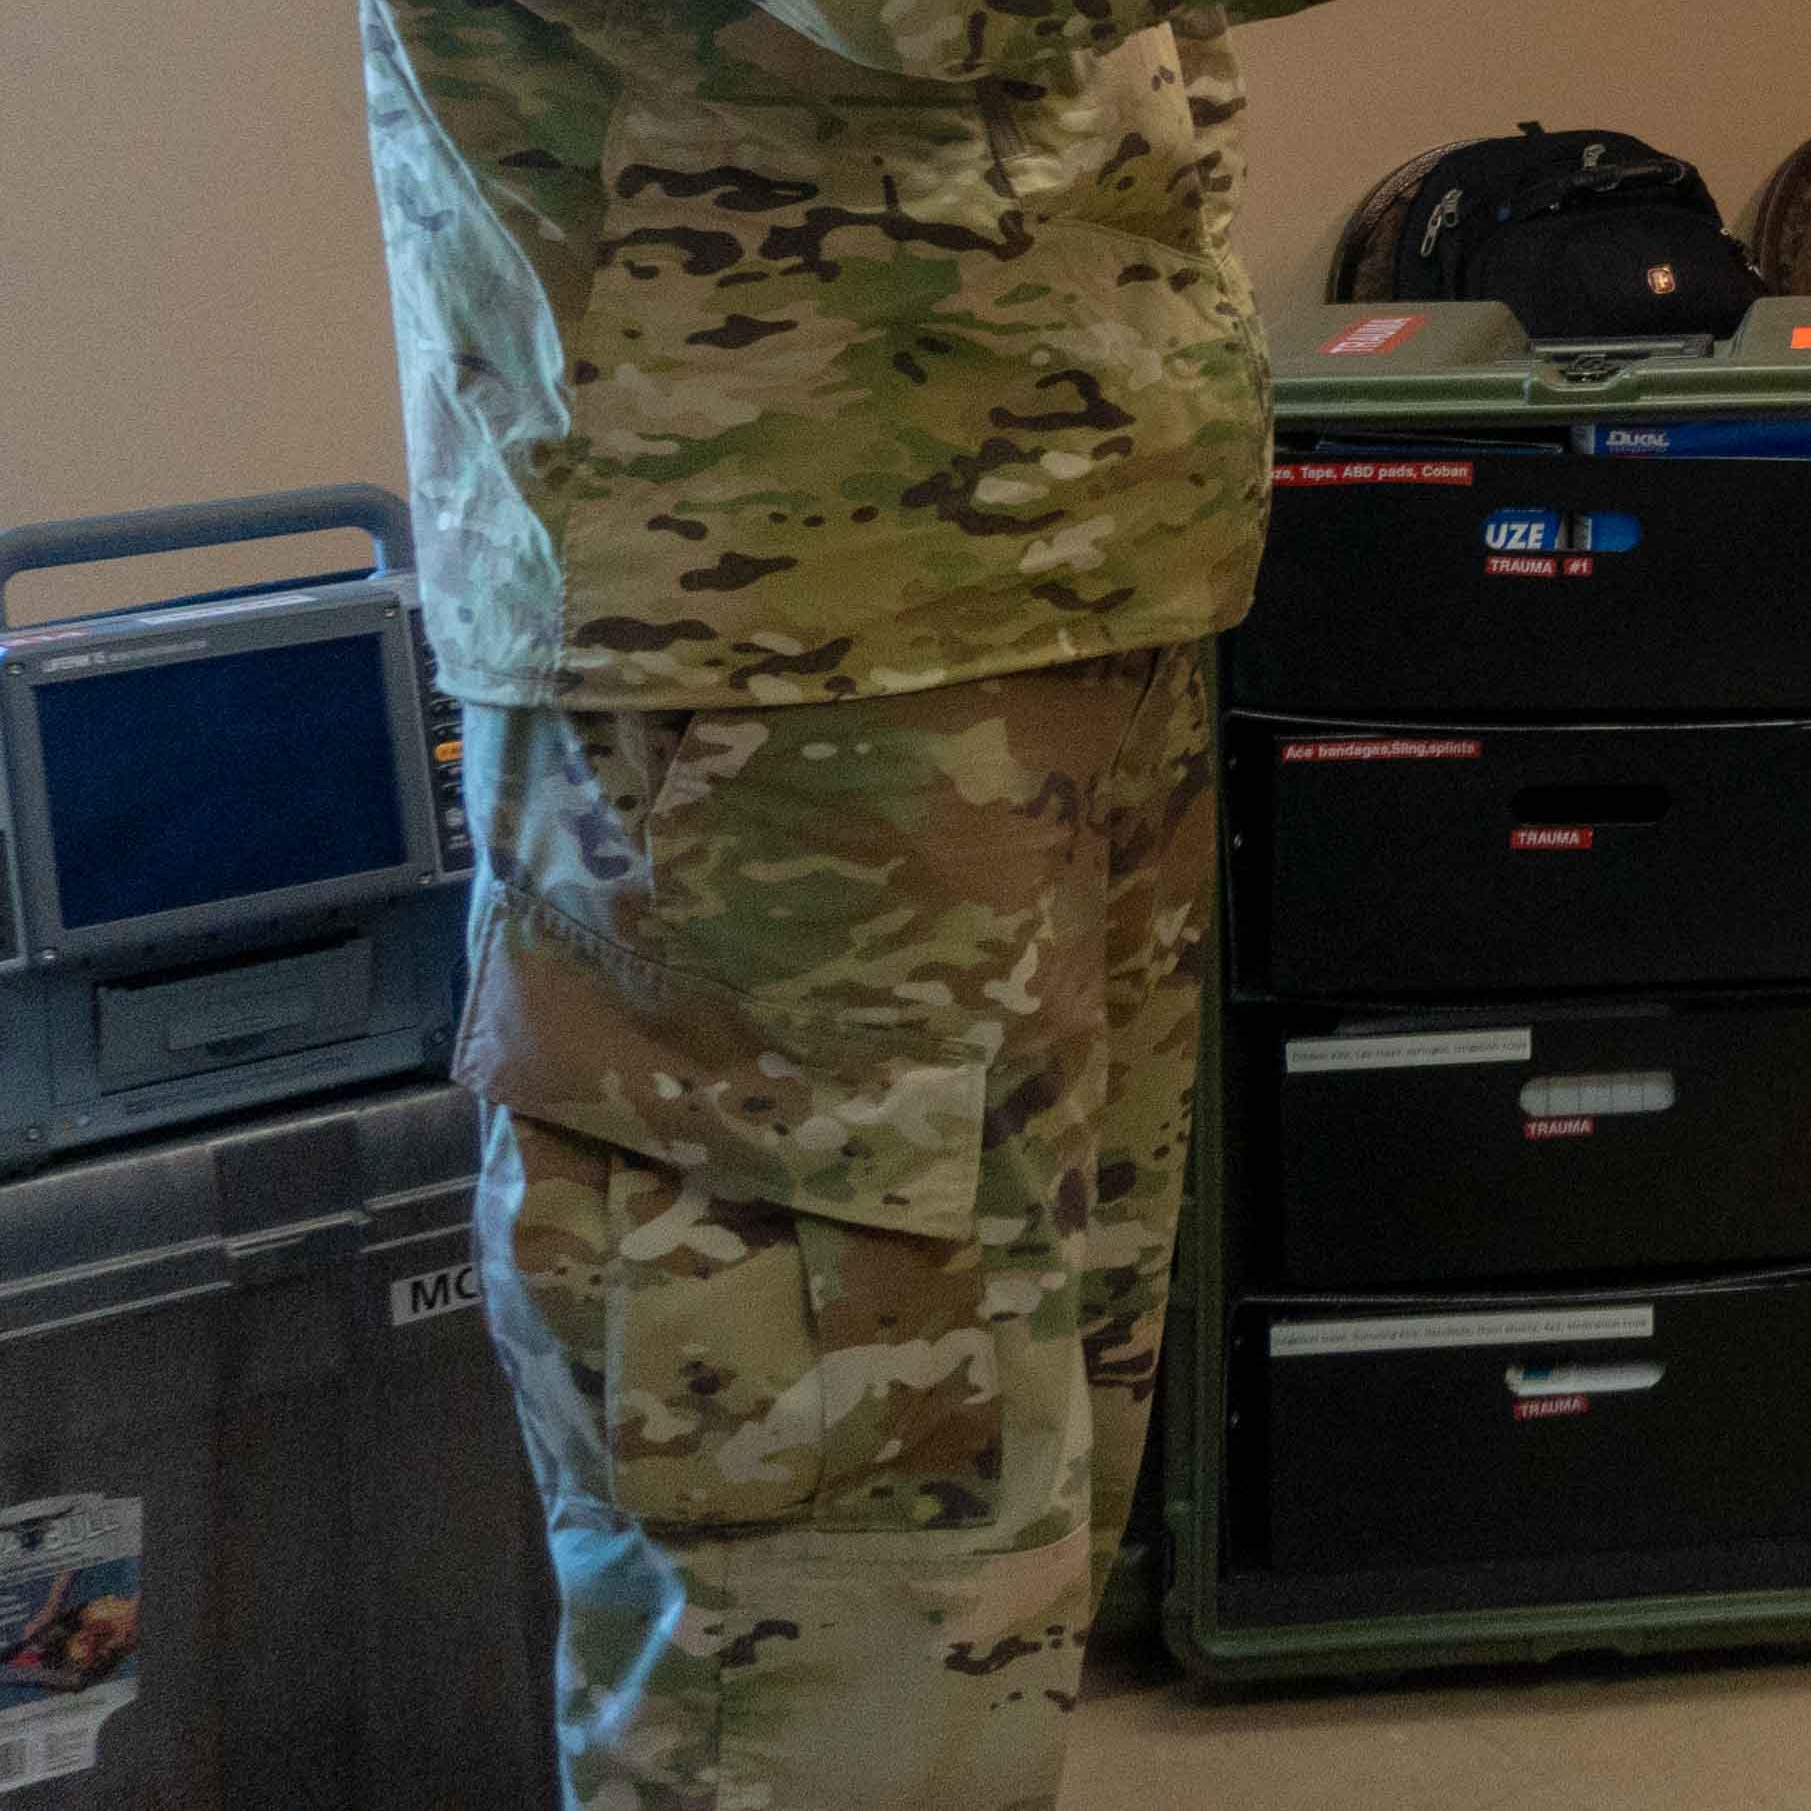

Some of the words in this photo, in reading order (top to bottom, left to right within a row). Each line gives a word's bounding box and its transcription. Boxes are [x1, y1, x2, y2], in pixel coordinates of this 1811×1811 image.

[1301, 466, 1337, 480] Tape,
[1343, 466, 1374, 478] ABD
[1378, 465, 1417, 481] pads,
[1421, 464, 1468, 477] Coban
[1485, 522, 1545, 551] UZE
[1489, 556, 1555, 575] TRAUMA
[1567, 557, 1590, 574] #1
[1286, 744, 1314, 760] Ace
[1518, 830, 1581, 847] TRAUMA
[1527, 1119, 1592, 1138] TRAUMA
[1518, 1397, 1584, 1418] TRAUMA
